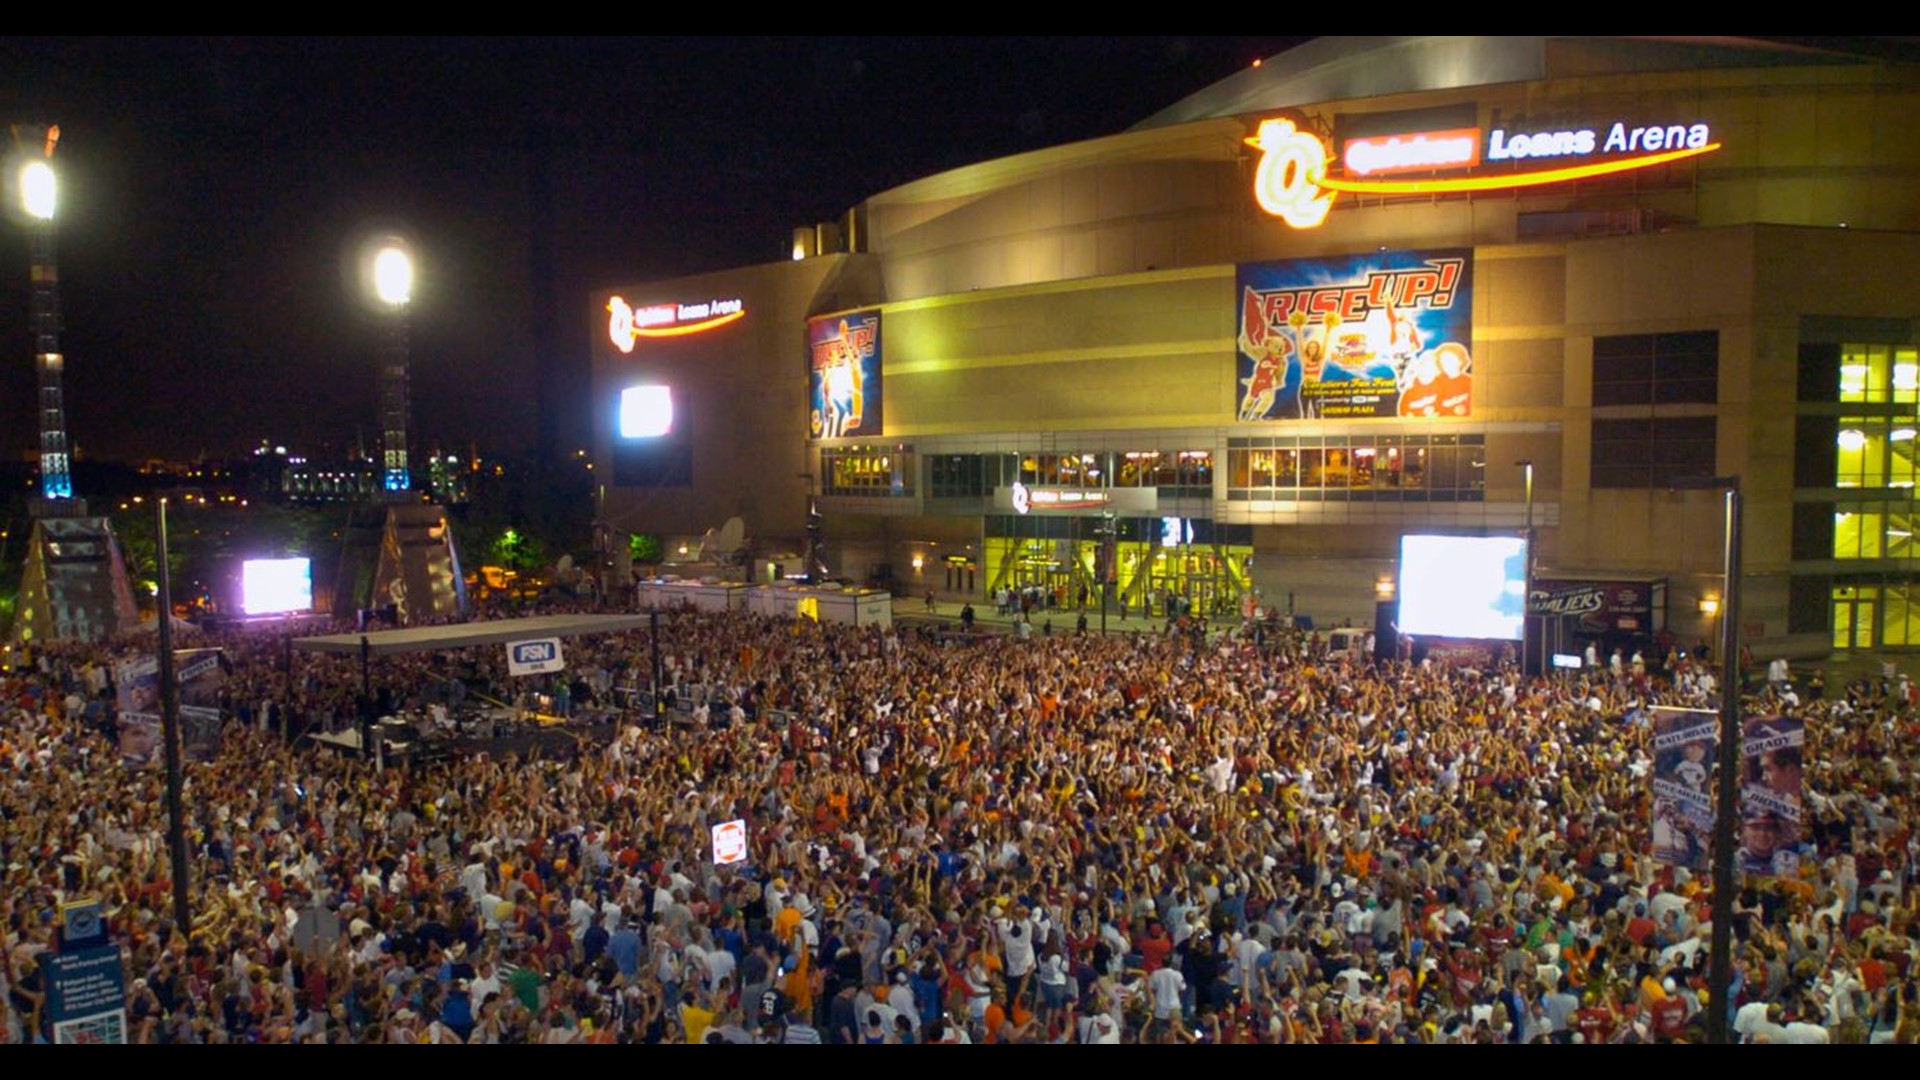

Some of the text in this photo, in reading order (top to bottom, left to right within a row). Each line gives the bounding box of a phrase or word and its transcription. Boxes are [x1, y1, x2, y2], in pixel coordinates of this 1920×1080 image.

[1602, 122, 1709, 152] Arena
[1657, 726, 1714, 746] SATURDAY
[1745, 735, 1791, 753] GRADY
